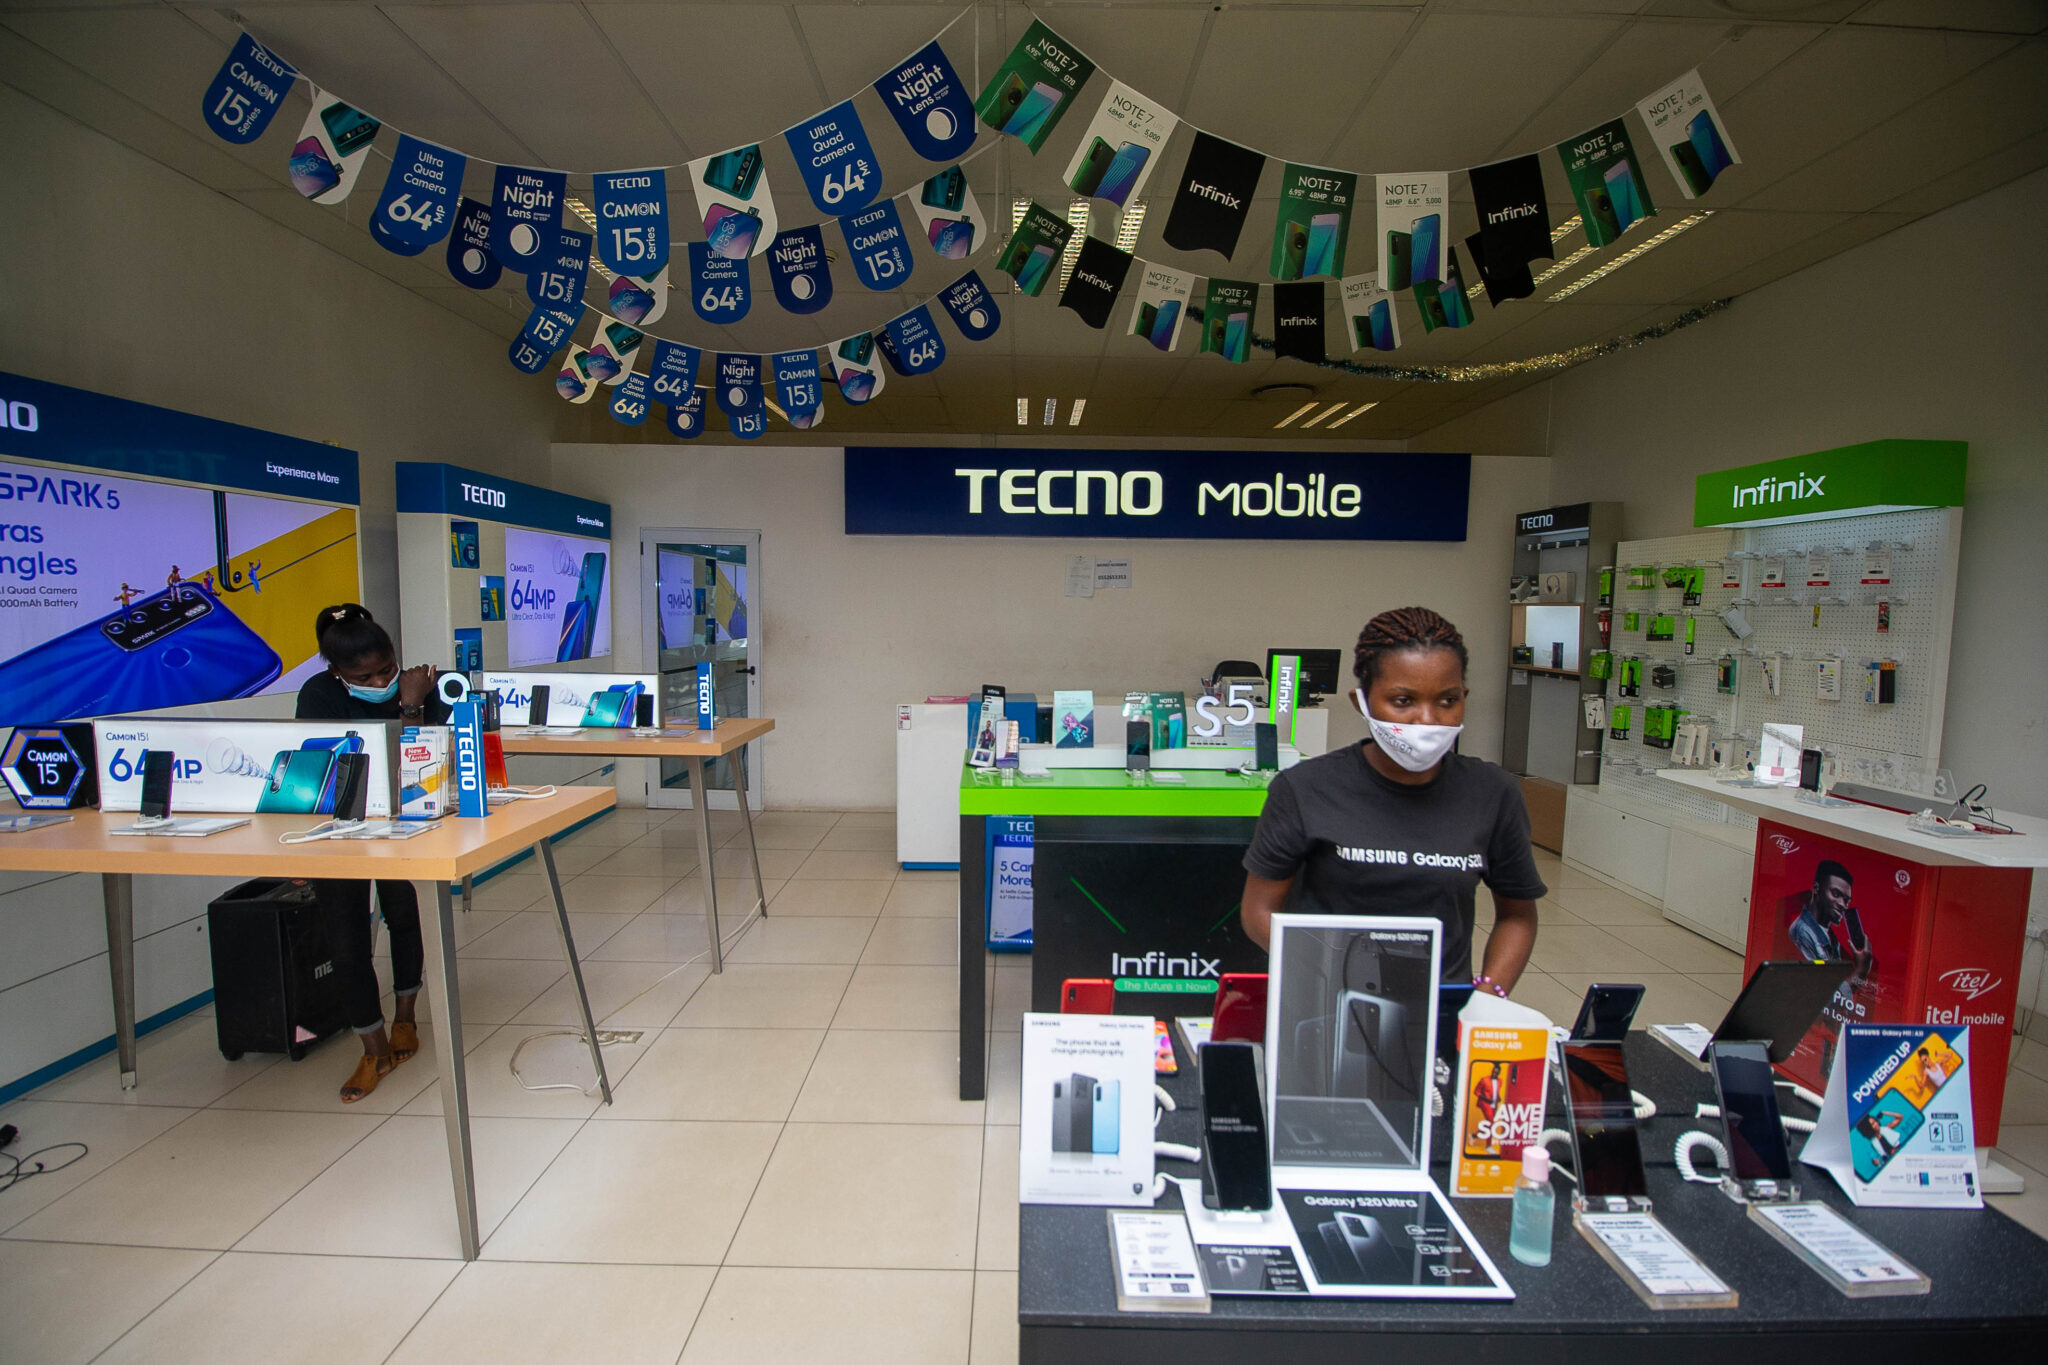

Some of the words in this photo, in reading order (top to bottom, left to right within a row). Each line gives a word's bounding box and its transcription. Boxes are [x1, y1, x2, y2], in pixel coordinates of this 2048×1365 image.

[250, 46, 284, 76] TECNO
[1038, 38, 1070, 68] NOTE
[1070, 61, 1078, 71] 7
[897, 62, 924, 83] Ultra
[893, 65, 944, 106] Night
[214, 86, 251, 126] 15
[237, 106, 261, 135] Series
[909, 95, 934, 114] Lens
[1112, 94, 1144, 120] NOTE
[1145, 113, 1154, 124] 7
[1649, 94, 1678, 118] NOTE
[1677, 89, 1683, 99] 7
[809, 122, 837, 139] Ultra
[813, 132, 844, 153] Quad
[1574, 136, 1605, 157] NOTE
[1605, 132, 1613, 143] 7
[418, 151, 444, 167] Ultra
[812, 142, 855, 167] Camera
[413, 163, 444, 181] Quad
[517, 175, 543, 187] Ultra
[823, 164, 864, 203] 64
[857, 159, 871, 177] MP
[403, 173, 446, 195] Camera
[608, 177, 651, 189] TECNO
[1298, 176, 1332, 190] NOTE
[1333, 181, 1342, 192] 7
[1385, 185, 1418, 195] NOTE
[1420, 184, 1427, 194] 7
[503, 185, 554, 209] Night
[1189, 180, 1240, 210] Infinix
[1309, 192, 1327, 200] 48MP
[388, 193, 432, 231] 64
[433, 204, 445, 223] MP
[507, 206, 531, 219] Lens
[603, 202, 660, 218] CAMON
[851, 210, 885, 227] TECNO
[1488, 202, 1539, 224] Infinix
[612, 228, 645, 261] 15
[647, 227, 656, 259] Series
[782, 236, 804, 246] Ultra
[853, 227, 899, 250] CAMON
[775, 242, 816, 263] Night
[702, 270, 738, 279] Camera
[706, 260, 732, 269] Quad
[783, 262, 803, 273] Lens
[865, 251, 895, 281] 15
[539, 272, 565, 301] 15
[1078, 270, 1113, 293] Infinix
[1149, 272, 1171, 283] NOTE
[701, 287, 736, 311] 64
[949, 283, 980, 309] Night
[1218, 288, 1241, 297] NOTE
[534, 316, 557, 340] 15
[1281, 317, 1317, 326] Infinix
[516, 343, 536, 364] 15
[730, 357, 747, 365] Ultra
[782, 354, 808, 363] TECNO
[910, 342, 935, 366] 64
[723, 364, 755, 378] Night
[726, 377, 741, 385] Lens
[654, 374, 681, 396] 64
[786, 385, 809, 406] 15
[614, 398, 638, 418] 64
[266, 462, 315, 481] Experience
[317, 471, 339, 484] More
[0, 472, 103, 508] SPARK
[107, 489, 120, 509] 5
[461, 483, 505, 508] TECNO
[955, 468, 1162, 516] TECNO
[1732, 472, 1826, 508] Infinix
[1521, 514, 1553, 530] TECNO
[0, 524, 43, 543] ras
[0, 552, 77, 581] ngles
[7, 586, 36, 594] Quad
[40, 586, 77, 594] Camera
[511, 579, 555, 610] 64MP
[0, 599, 41, 607] 000mAh
[44, 599, 78, 608] Battery
[699, 674, 709, 714] TECNO
[1278, 667, 1292, 713] Infinix
[106, 732, 136, 741] CAMON
[28, 750, 67, 762] CAMON
[458, 723, 476, 790] TECNO
[37, 764, 59, 785] 15
[1008, 821, 1033, 831] TEC
[1775, 837, 1793, 849] itel
[1000, 861, 1007, 872] 5
[1413, 852, 1467, 871] Galaxy
[1112, 952, 1220, 976] Infinix
[1124, 981, 1140, 989] The
[1144, 982, 1172, 991] future
[1186, 983, 1210, 991] Now!
[1953, 973, 1989, 988] itel
[1833, 991, 1854, 1011] Pro
[1926, 1005, 1959, 1024] itel
[1962, 1014, 2004, 1024] mobile
[1473, 1040, 1505, 1050] Galaxy
[1474, 1031, 1518, 1039] SAMSUNG
[1853, 1052, 1900, 1103] POWERED
[1896, 1041, 1911, 1058] UP
[1493, 1104, 1542, 1122] AWE
[1477, 1121, 1541, 1139] SOME
[1304, 1196, 1356, 1208] Galaxy
[1383, 1198, 1418, 1208] Ultra
